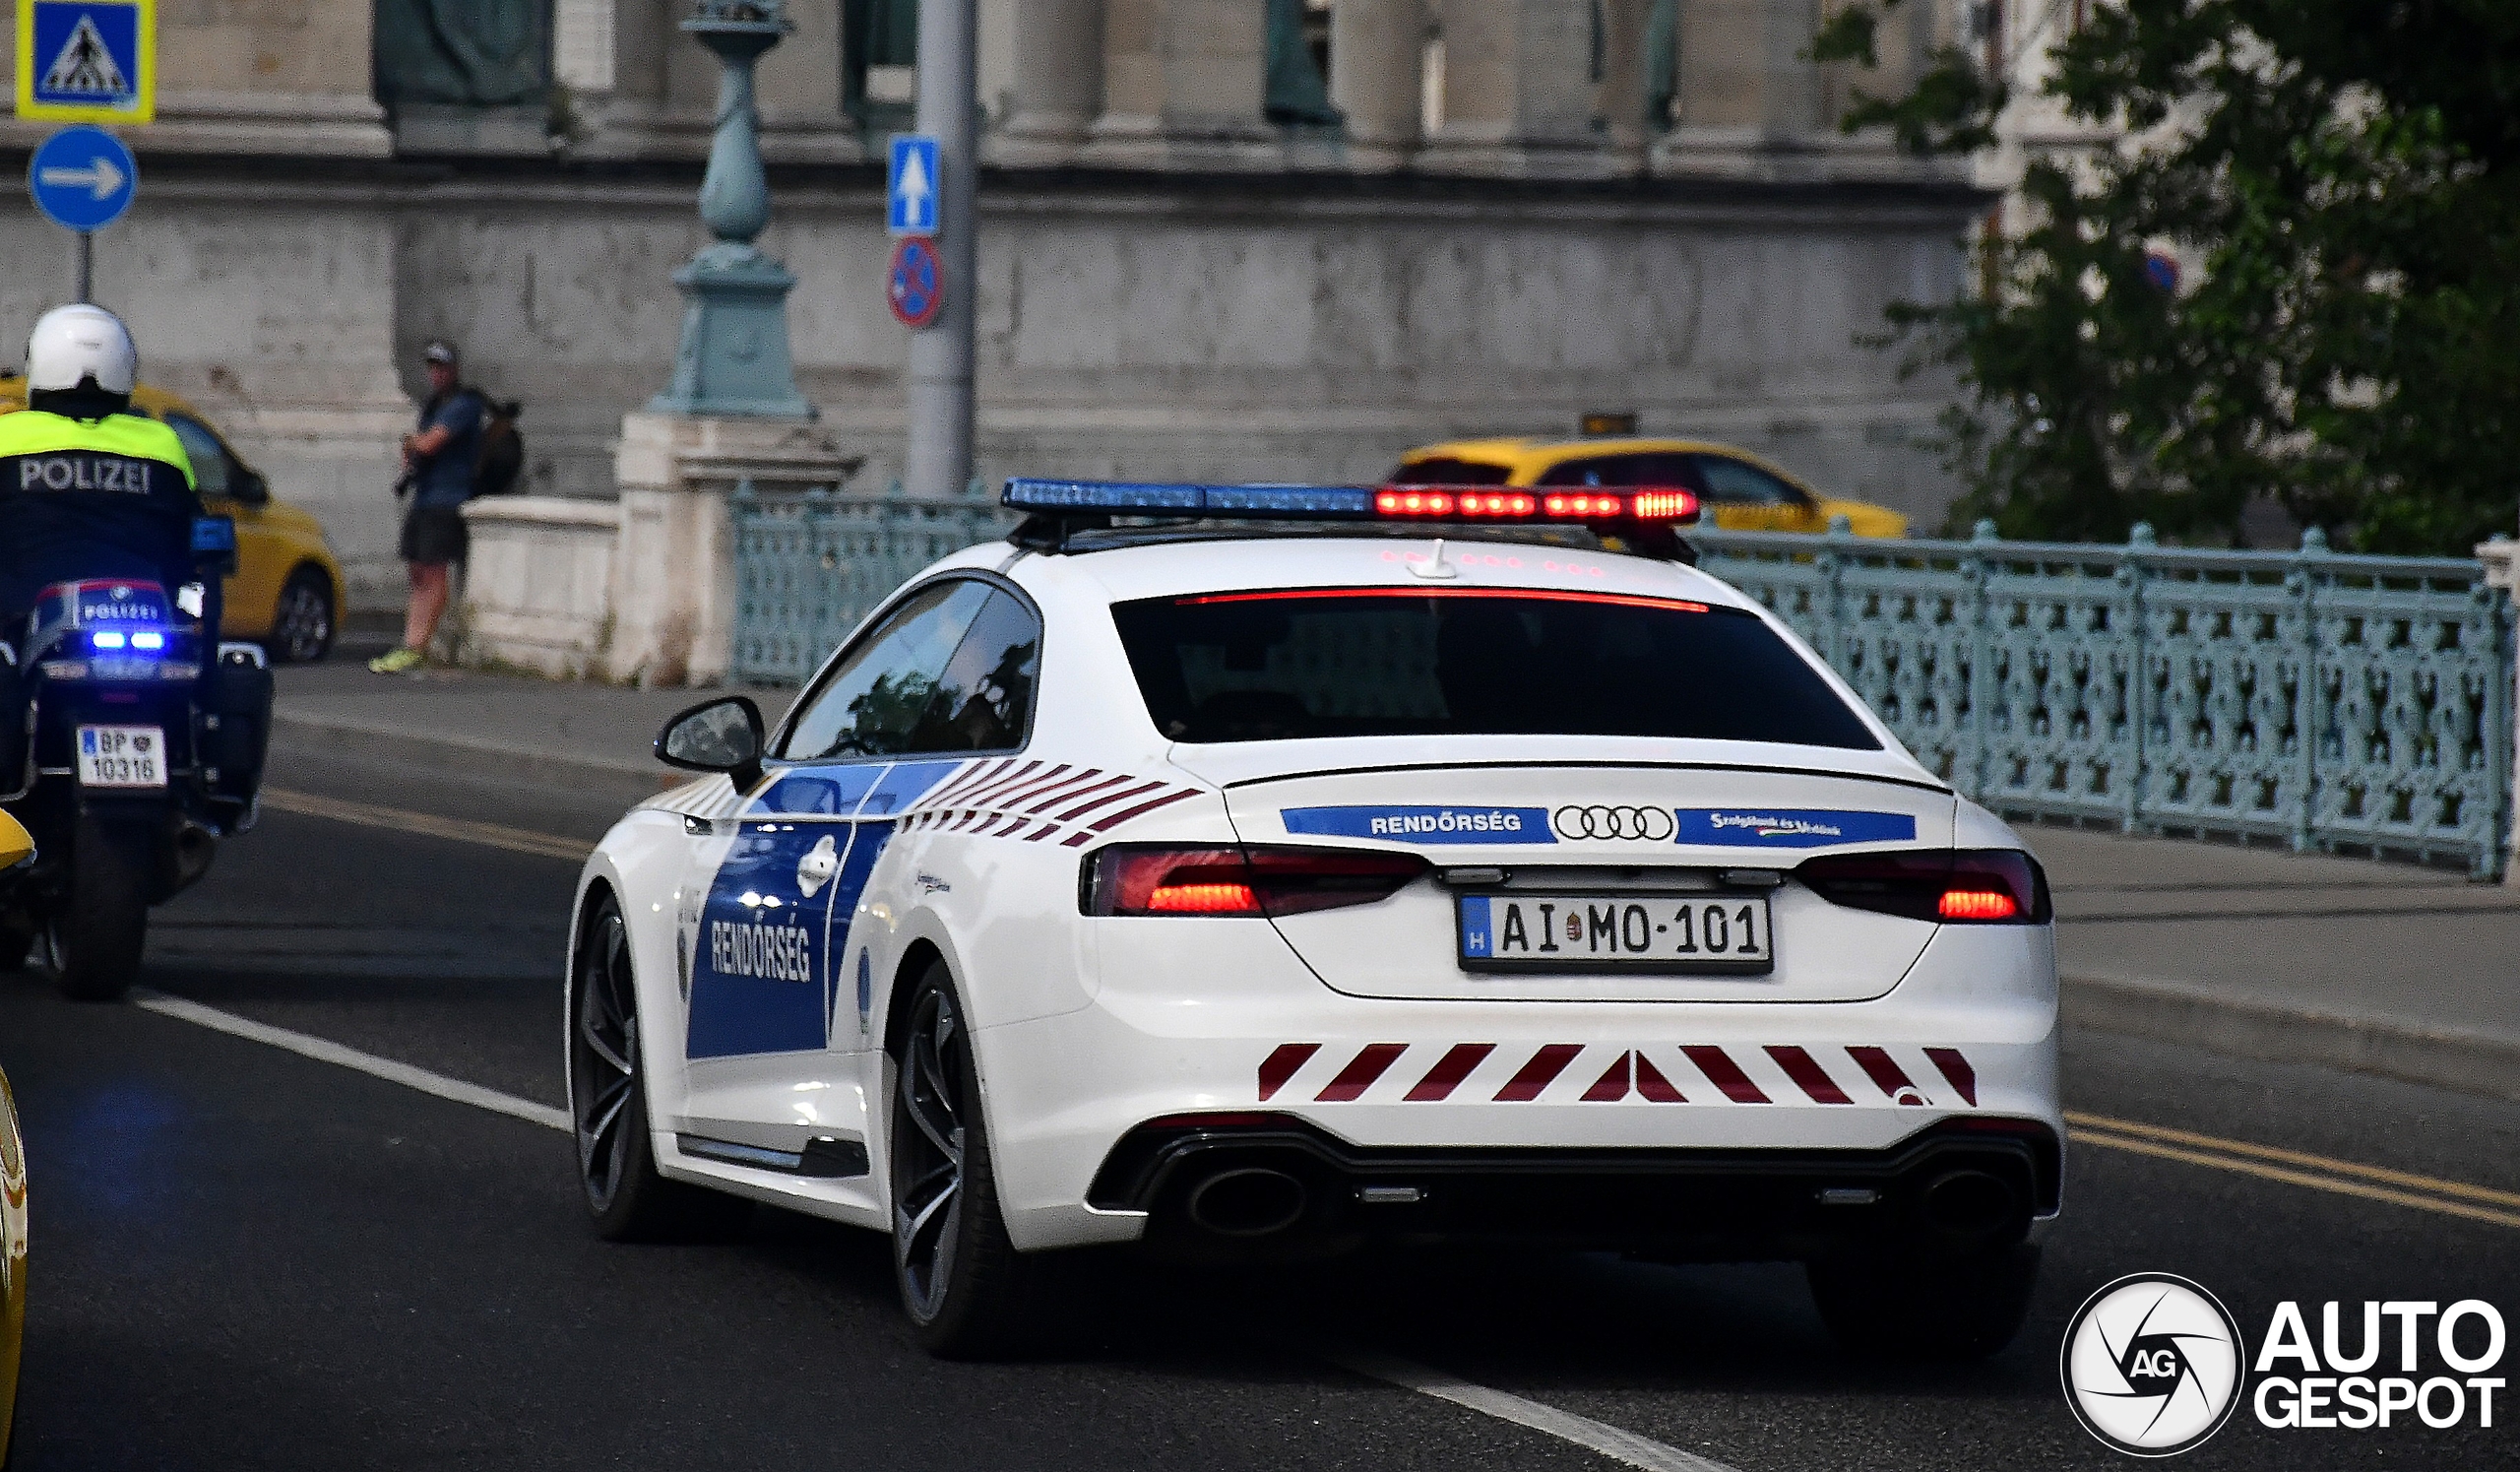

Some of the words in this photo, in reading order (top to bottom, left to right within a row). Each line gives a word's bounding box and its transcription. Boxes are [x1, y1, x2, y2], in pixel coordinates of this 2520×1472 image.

[20, 458, 150, 493] POLIZEI
[84, 603, 158, 620] POLIZEI
[101, 731, 126, 753] BP
[94, 757, 154, 781] 10316
[1370, 810, 1522, 835] RENDŐRSÉG
[1502, 903, 1559, 952] AI
[1470, 931, 1484, 950] H
